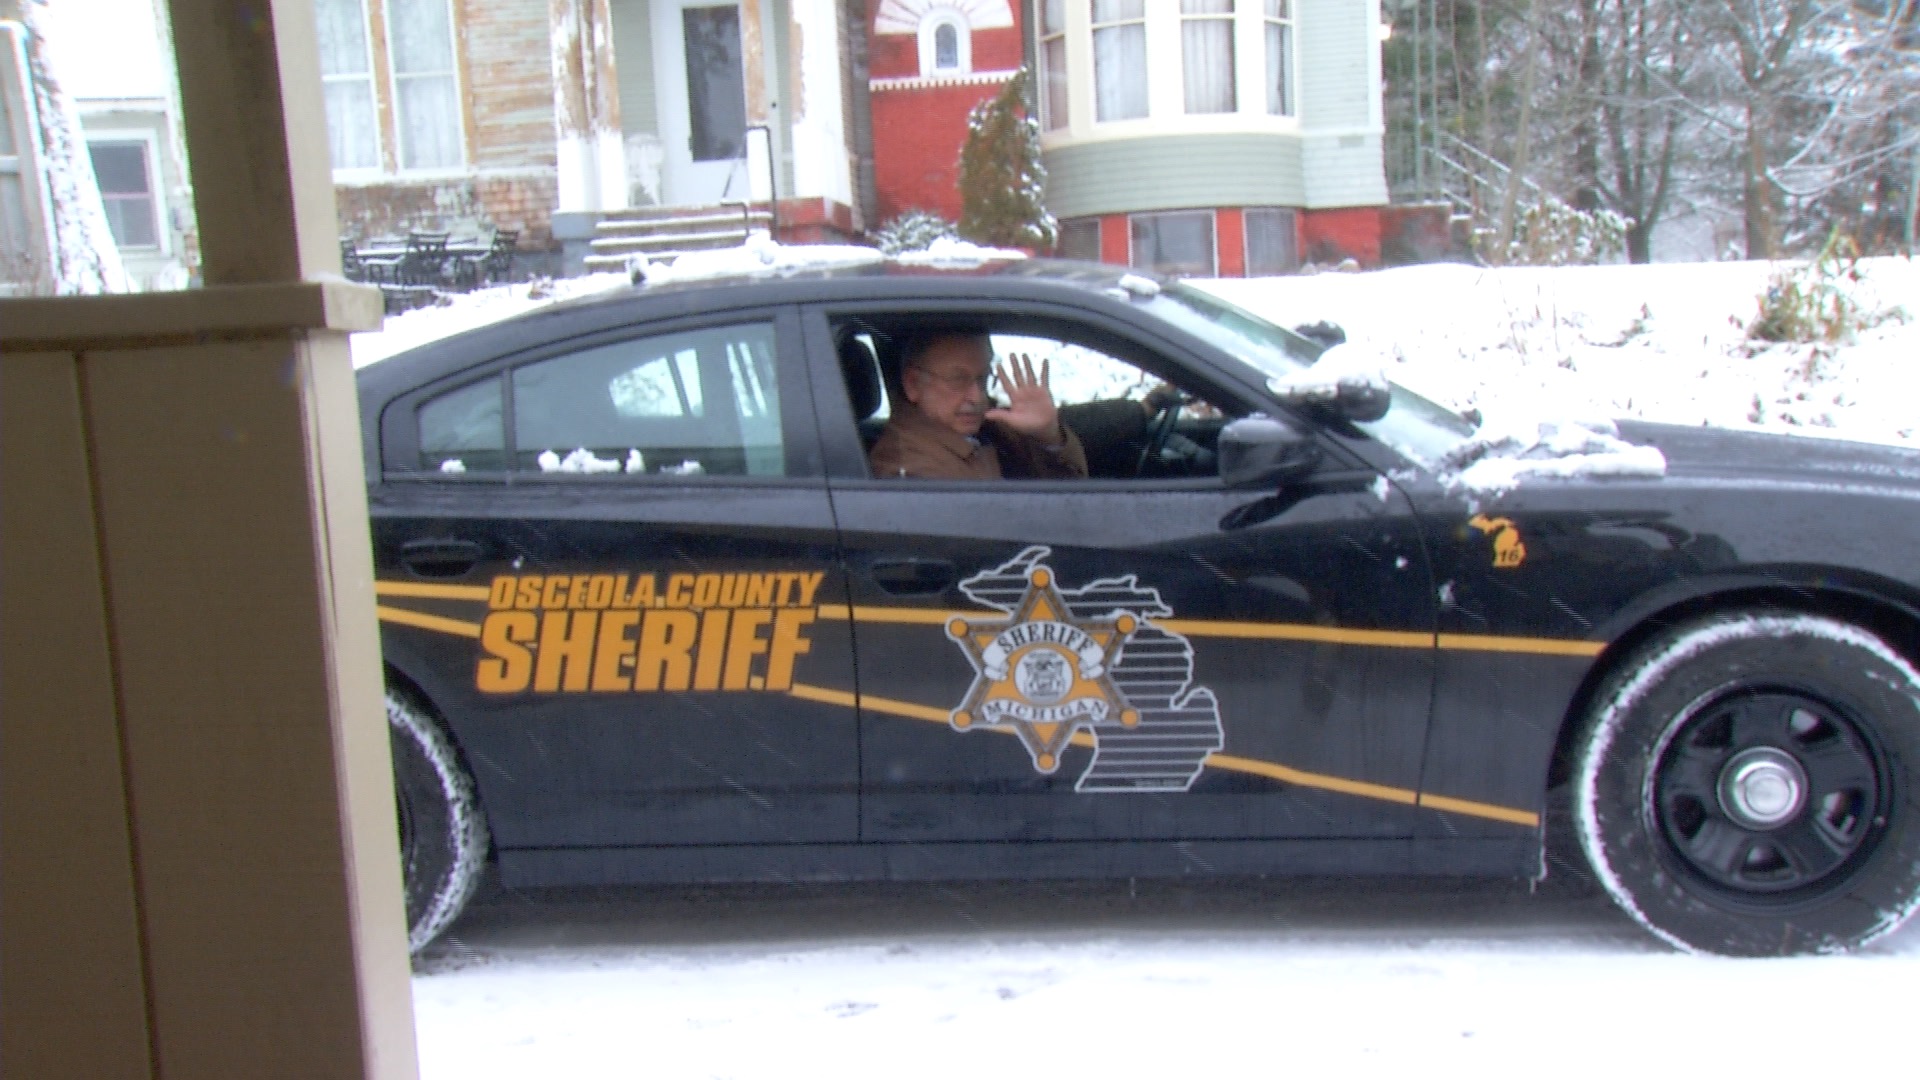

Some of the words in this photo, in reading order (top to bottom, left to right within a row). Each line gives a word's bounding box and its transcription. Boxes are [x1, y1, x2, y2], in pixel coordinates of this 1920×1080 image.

[487, 573, 656, 610] OSCEOLA
[665, 571, 824, 608] COUNTY
[475, 608, 816, 693] SHERIFF
[998, 624, 1094, 655] SHERIFF
[986, 701, 1105, 719] MICHIGAN
